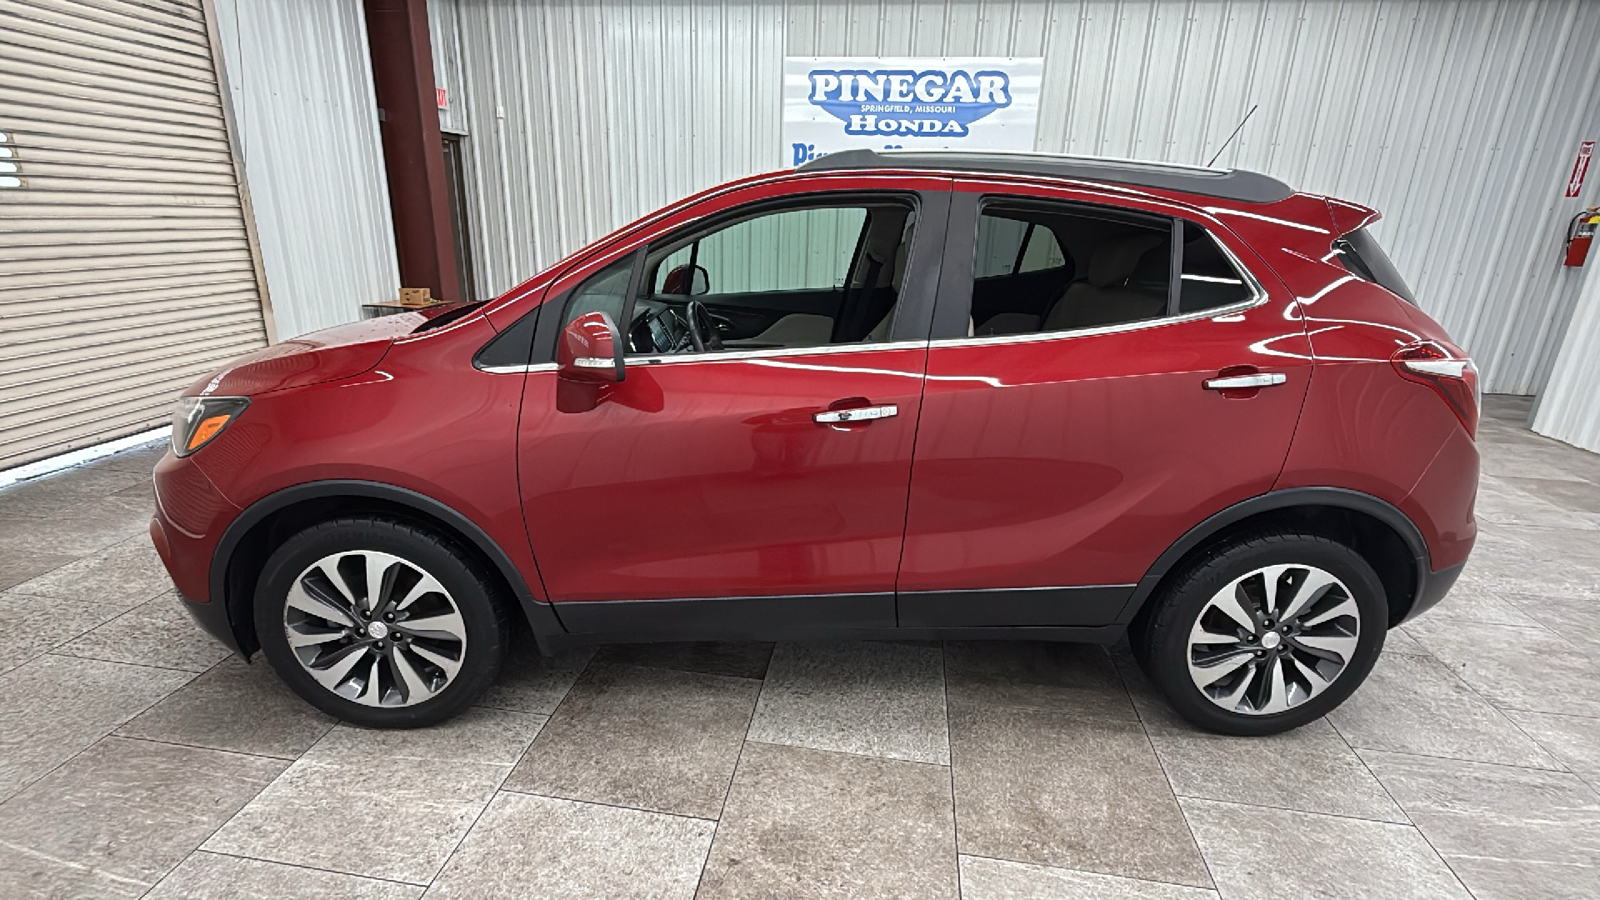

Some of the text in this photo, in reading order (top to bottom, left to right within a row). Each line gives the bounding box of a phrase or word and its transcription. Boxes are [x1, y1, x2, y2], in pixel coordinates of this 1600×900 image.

[812, 74, 1008, 104] PINEGAR
[860, 104, 956, 114] SPRINGFIELD, MISSOURI
[849, 114, 964, 134] HONDA
